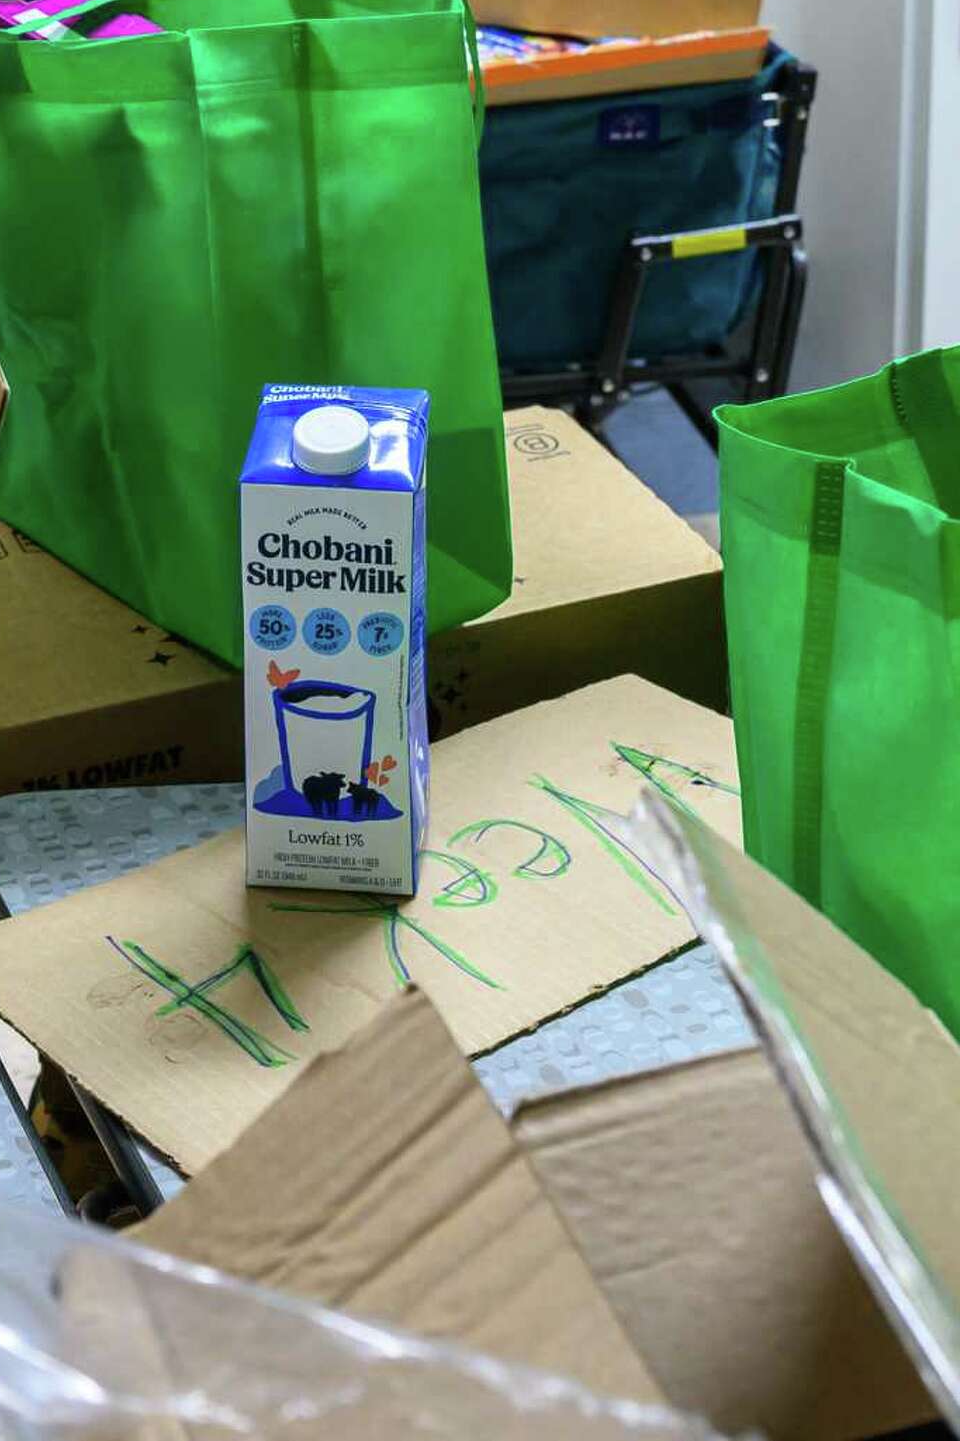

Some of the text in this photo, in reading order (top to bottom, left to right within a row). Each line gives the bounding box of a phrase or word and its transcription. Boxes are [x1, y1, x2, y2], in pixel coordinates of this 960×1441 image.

[257, 532, 394, 565] Chobani
[67, 744, 185, 789] LOWFAT
[288, 829, 365, 847] Lowfat 1%
